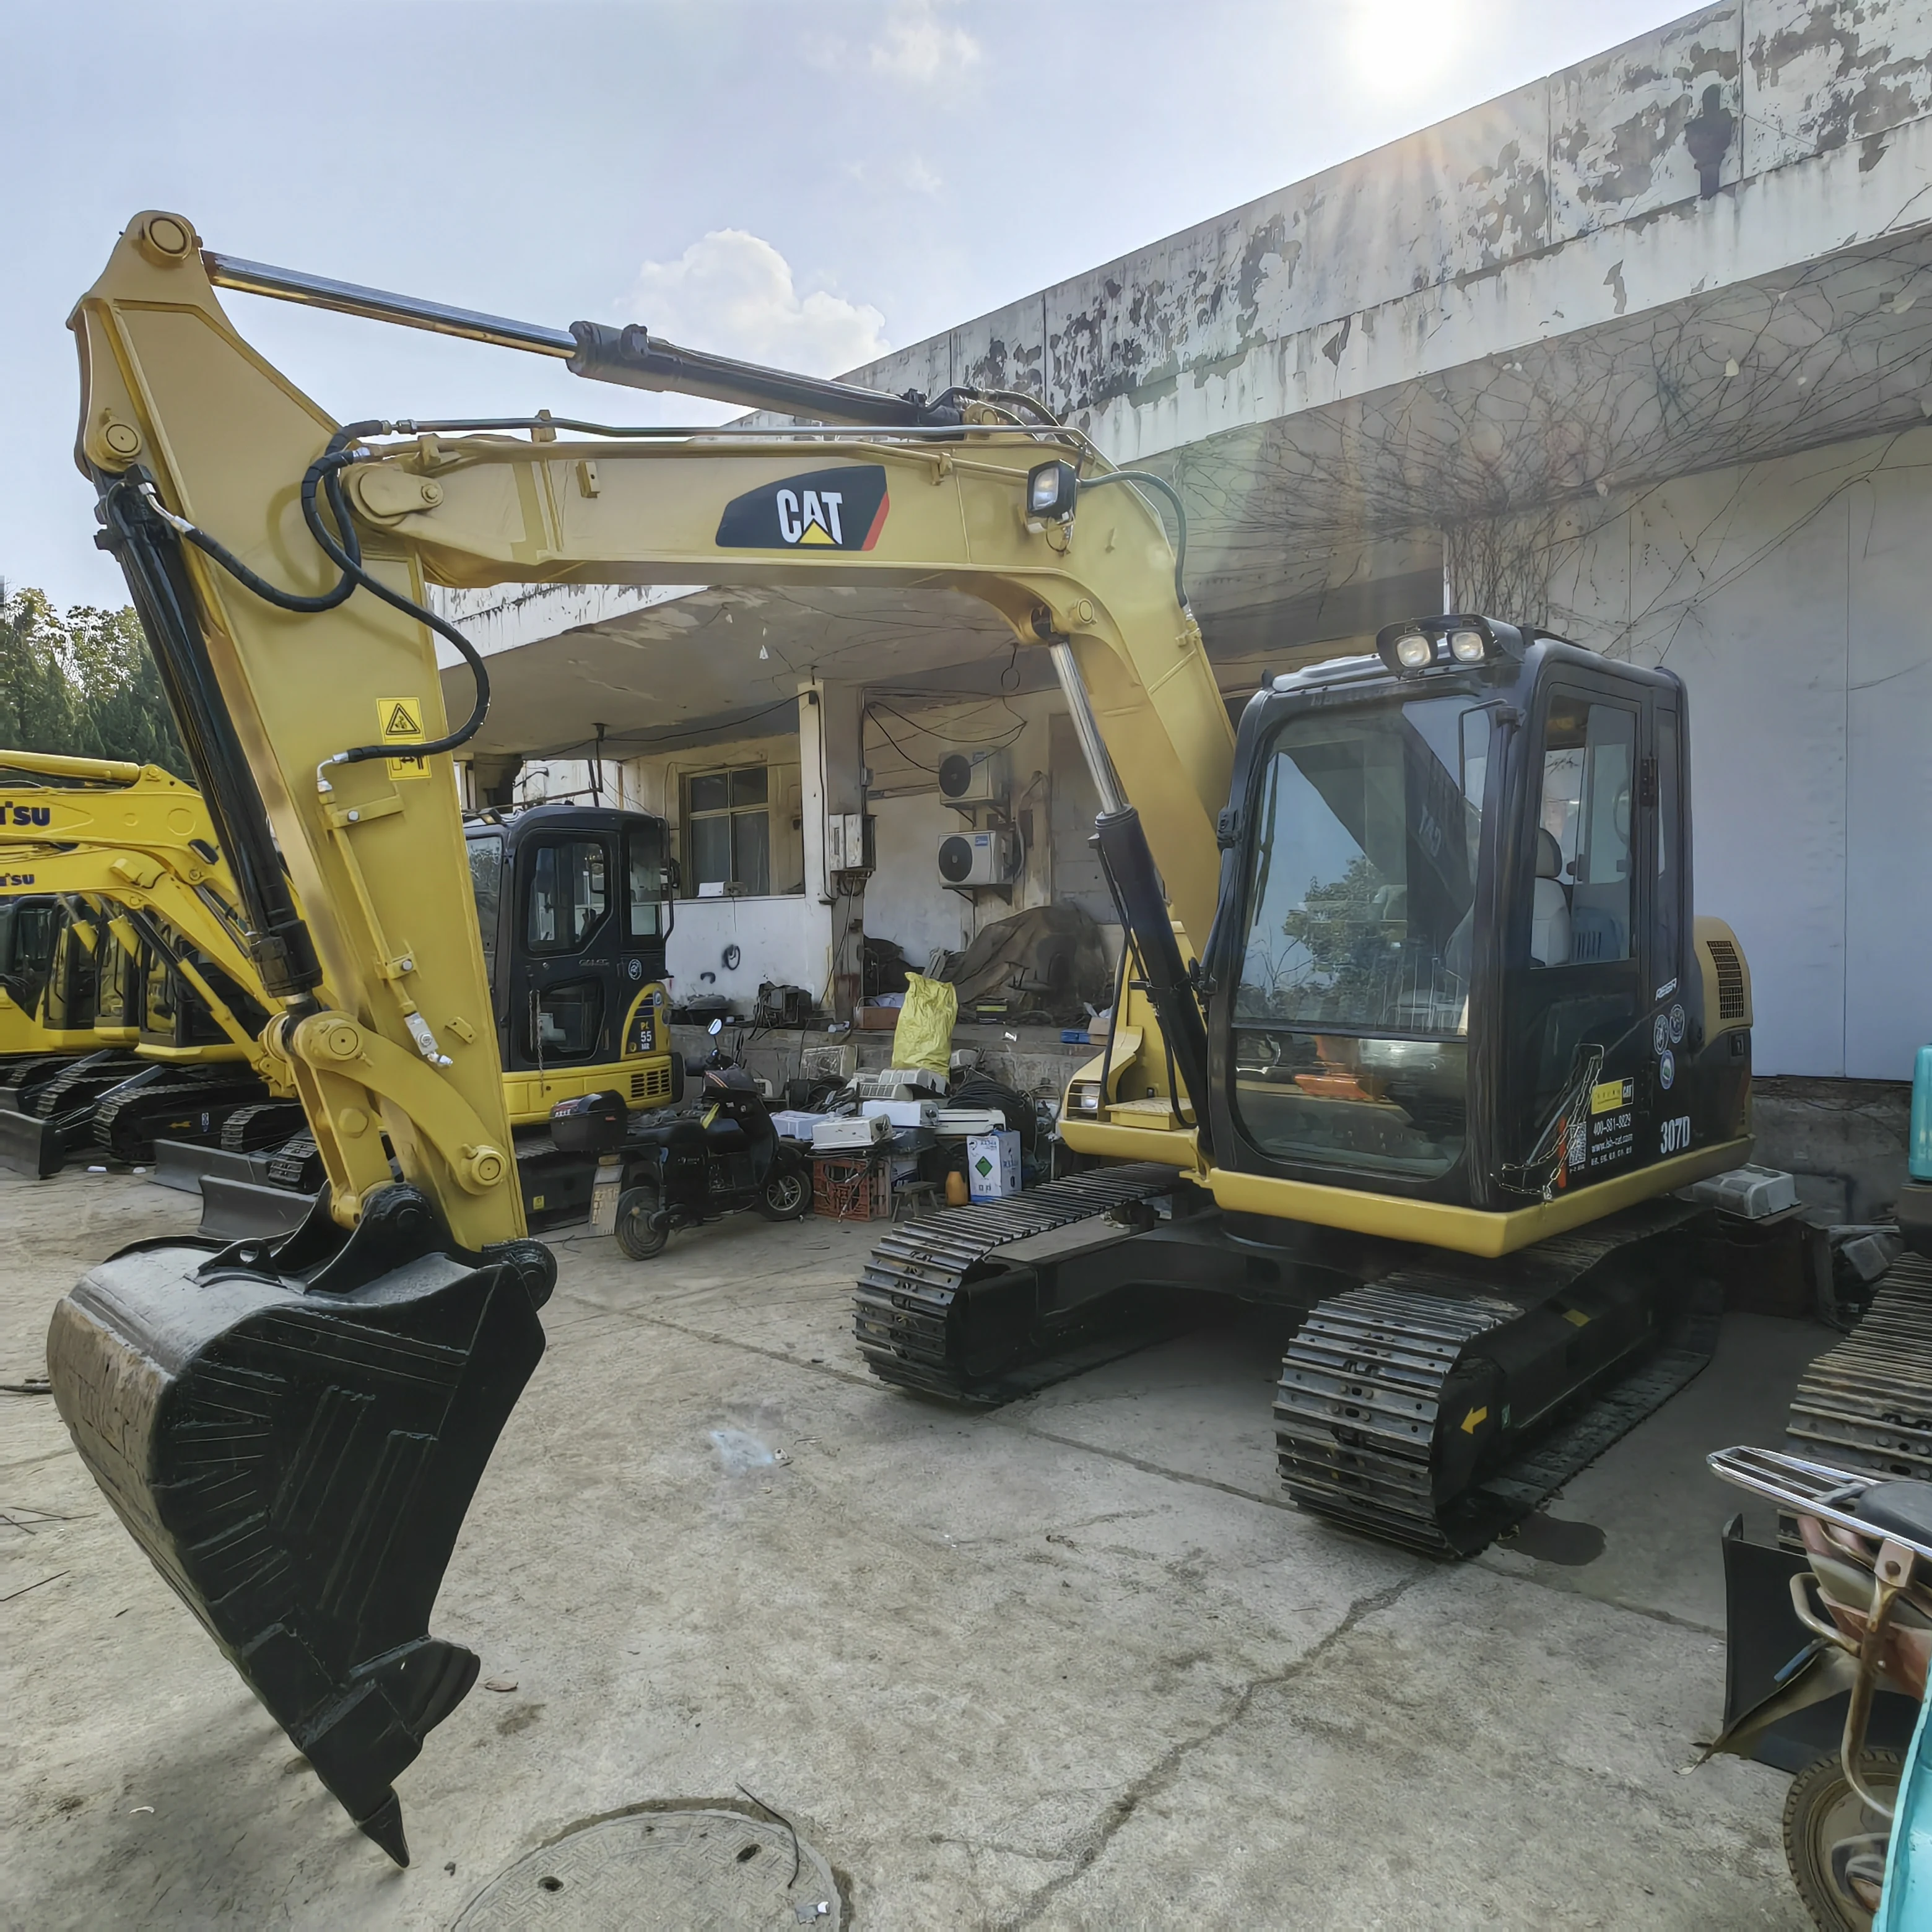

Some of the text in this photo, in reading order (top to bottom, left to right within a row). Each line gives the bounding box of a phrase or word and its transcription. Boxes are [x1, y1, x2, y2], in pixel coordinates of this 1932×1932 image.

[777, 489, 843, 544] CAT
[640, 1030, 651, 1043] 55
[1661, 1116, 1690, 1154] 307D
